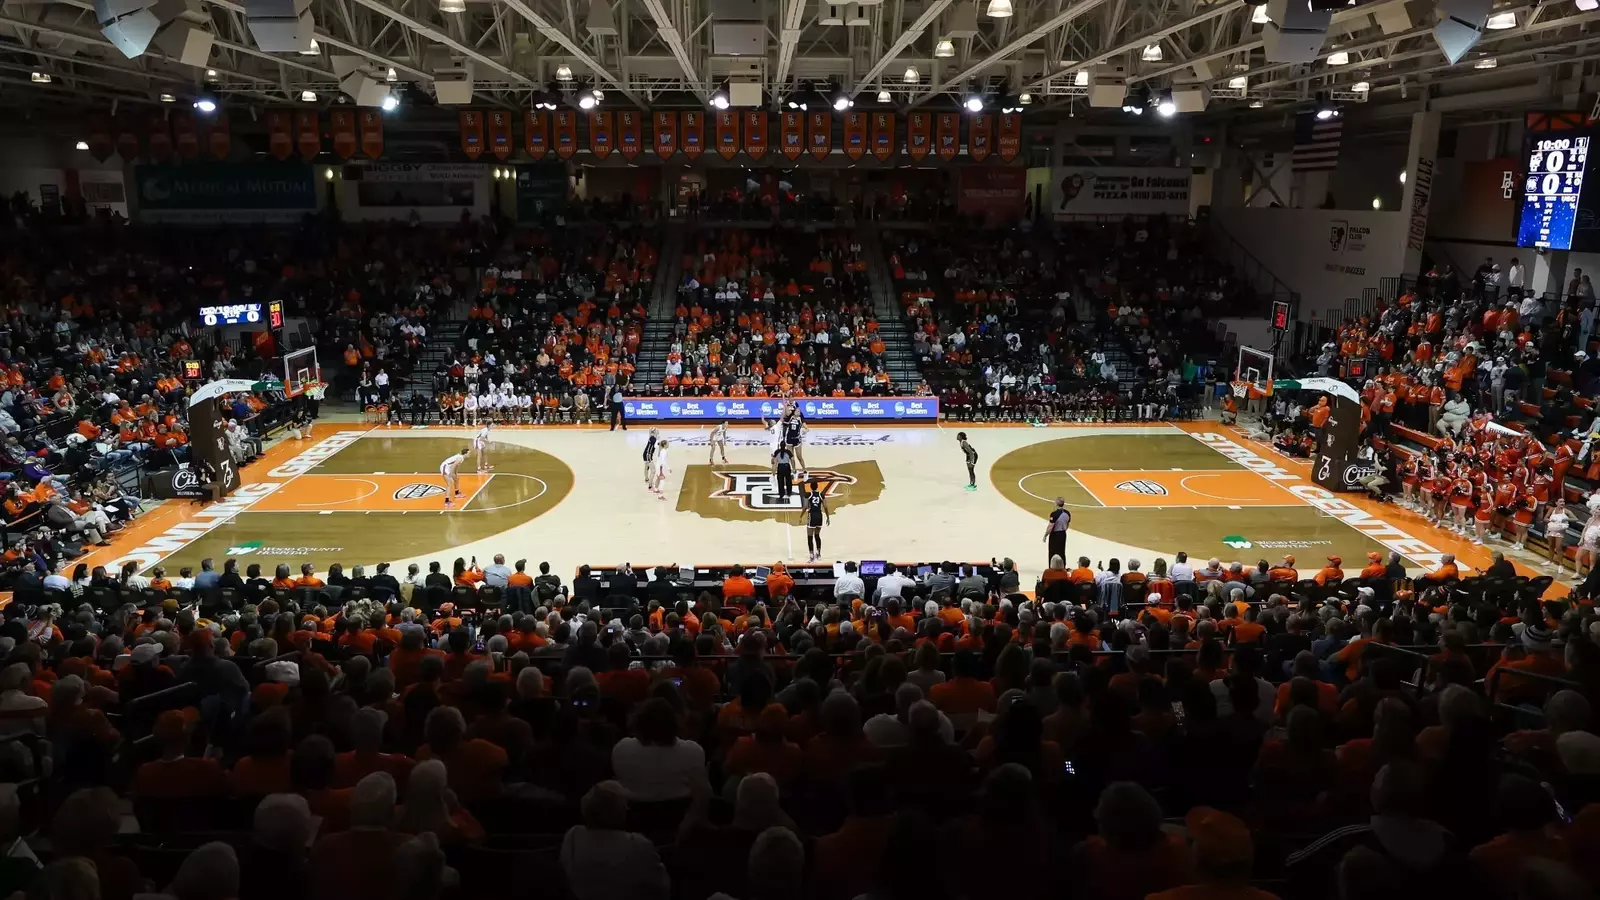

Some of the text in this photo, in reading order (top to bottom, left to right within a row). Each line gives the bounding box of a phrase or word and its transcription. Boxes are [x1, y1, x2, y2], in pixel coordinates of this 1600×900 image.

[1537, 139, 1569, 150] 10:00
[1546, 151, 1564, 172] 0
[174, 178, 308, 194] MEDICAL MUTUAL
[1131, 176, 1144, 187] Go
[1146, 176, 1188, 188] Falcons!
[1542, 174, 1560, 194] 0
[1094, 191, 1127, 199] PIZZA
[1408, 157, 1434, 252] ZIGGY VILLE
[204, 314, 217, 326] 0
[247, 311, 259, 322] 0
[267, 430, 368, 478] GREEN
[1190, 432, 1303, 480] STROH
[102, 482, 283, 576] OWLING
